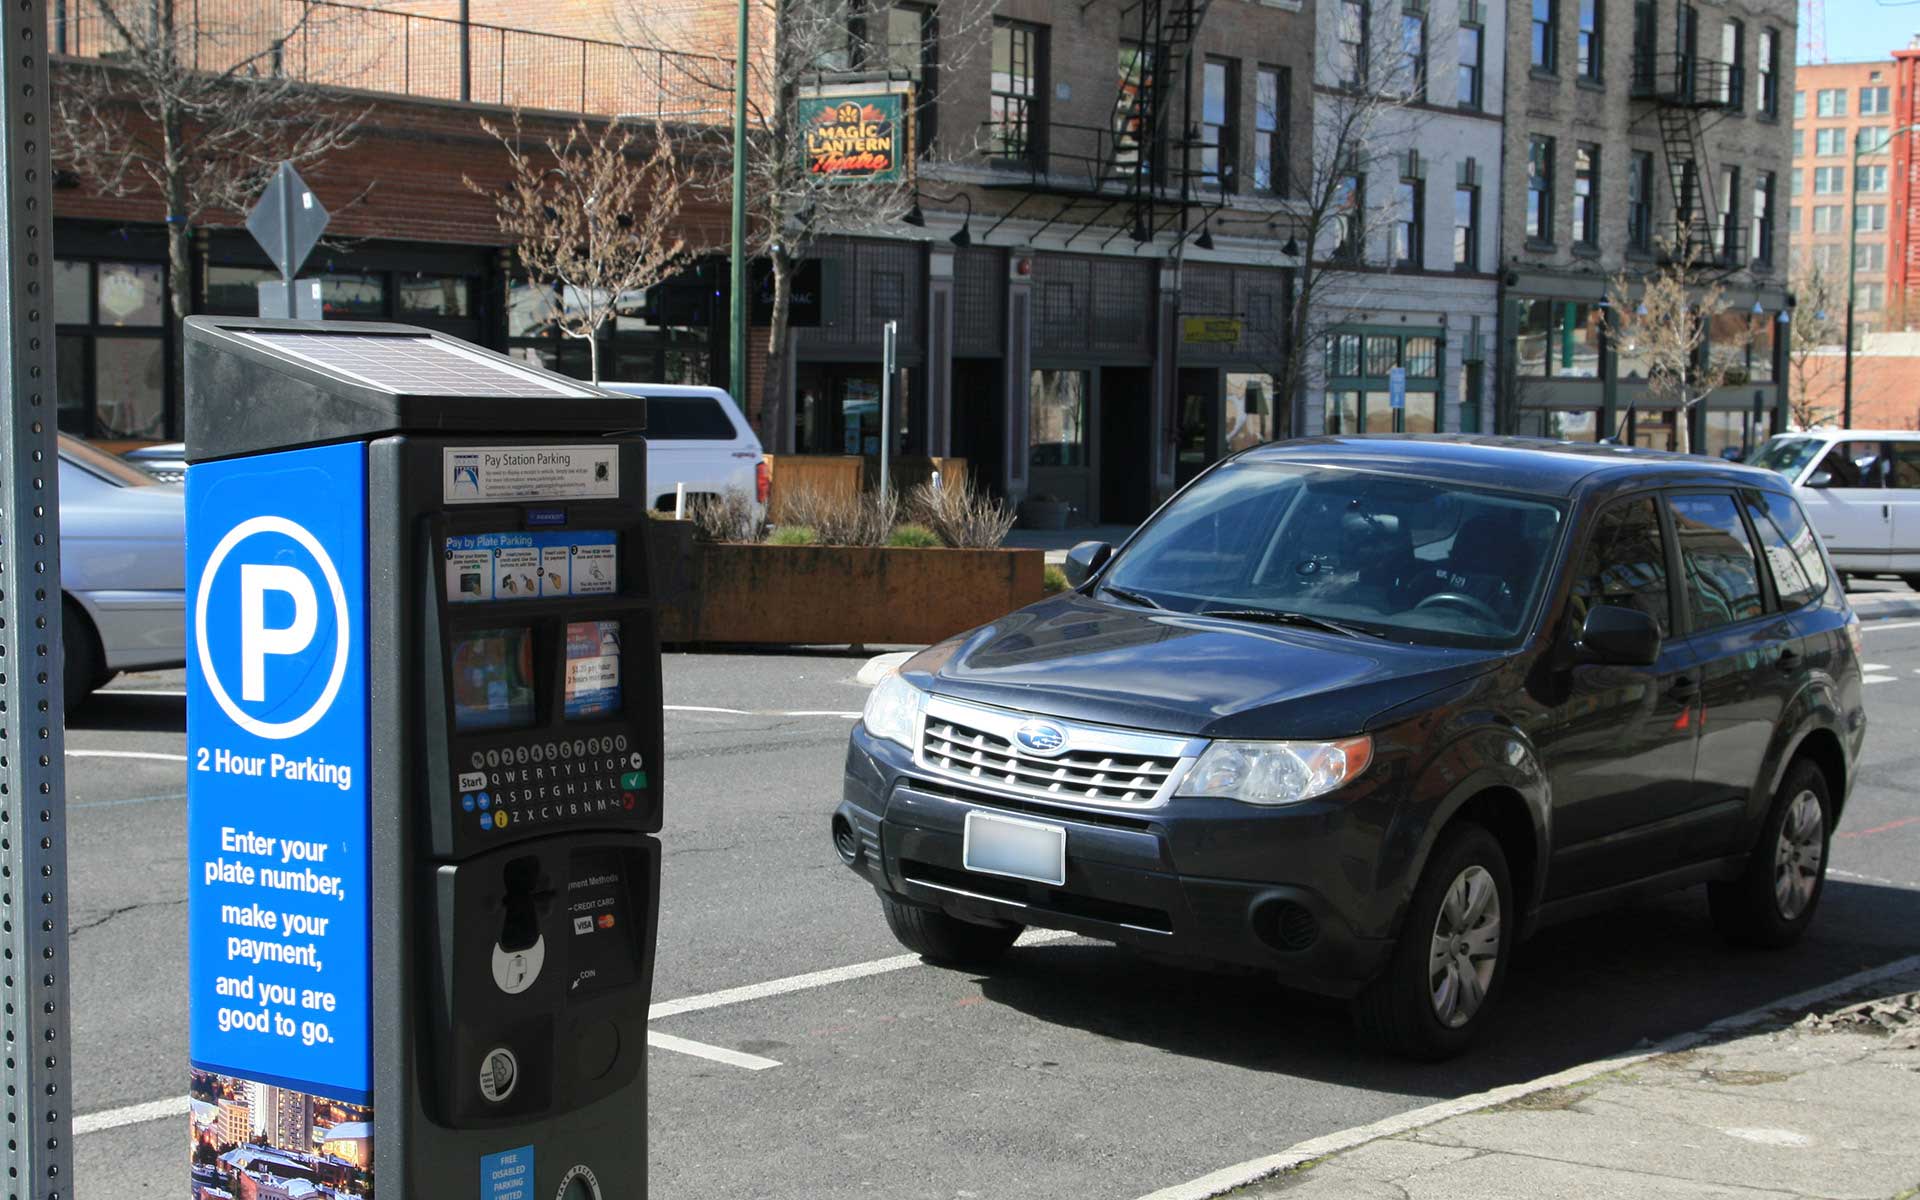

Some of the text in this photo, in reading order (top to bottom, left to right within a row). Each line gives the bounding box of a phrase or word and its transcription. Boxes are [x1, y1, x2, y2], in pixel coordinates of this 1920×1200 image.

[818, 121, 878, 139] MAGIC
[807, 132, 890, 154] LANTERN
[485, 454, 501, 468] Pay
[503, 454, 534, 466] Station
[537, 453, 571, 467] Parking
[446, 535, 533, 549] Pay by Plate Parking
[240, 564, 318, 702] P
[196, 747, 352, 790] 2 Hour Parking
[491, 757, 627, 785] Q W E R T Y U I O P
[461, 777, 483, 788] Start
[495, 778, 616, 805] A S D F G H J K L
[512, 811, 520, 823] Z
[527, 809, 535, 821] X
[541, 807, 549, 819] C
[555, 805, 563, 816] V
[583, 801, 592, 812] N
[597, 799, 606, 811] M
[221, 827, 328, 864] Enter your
[205, 857, 345, 901] plate number,
[589, 874, 618, 886] Methods
[573, 897, 615, 911] CREDIT CARD
[222, 903, 329, 937] make your
[576, 920, 592, 930] VISA
[228, 936, 323, 972] payment,
[580, 969, 596, 979] COIN
[216, 975, 336, 1013] and you are
[218, 1008, 334, 1046] good to go.
[500, 1154, 518, 1166] FREE
[492, 1164, 526, 1180] DISABLED
[494, 1177, 524, 1192] PARKING
